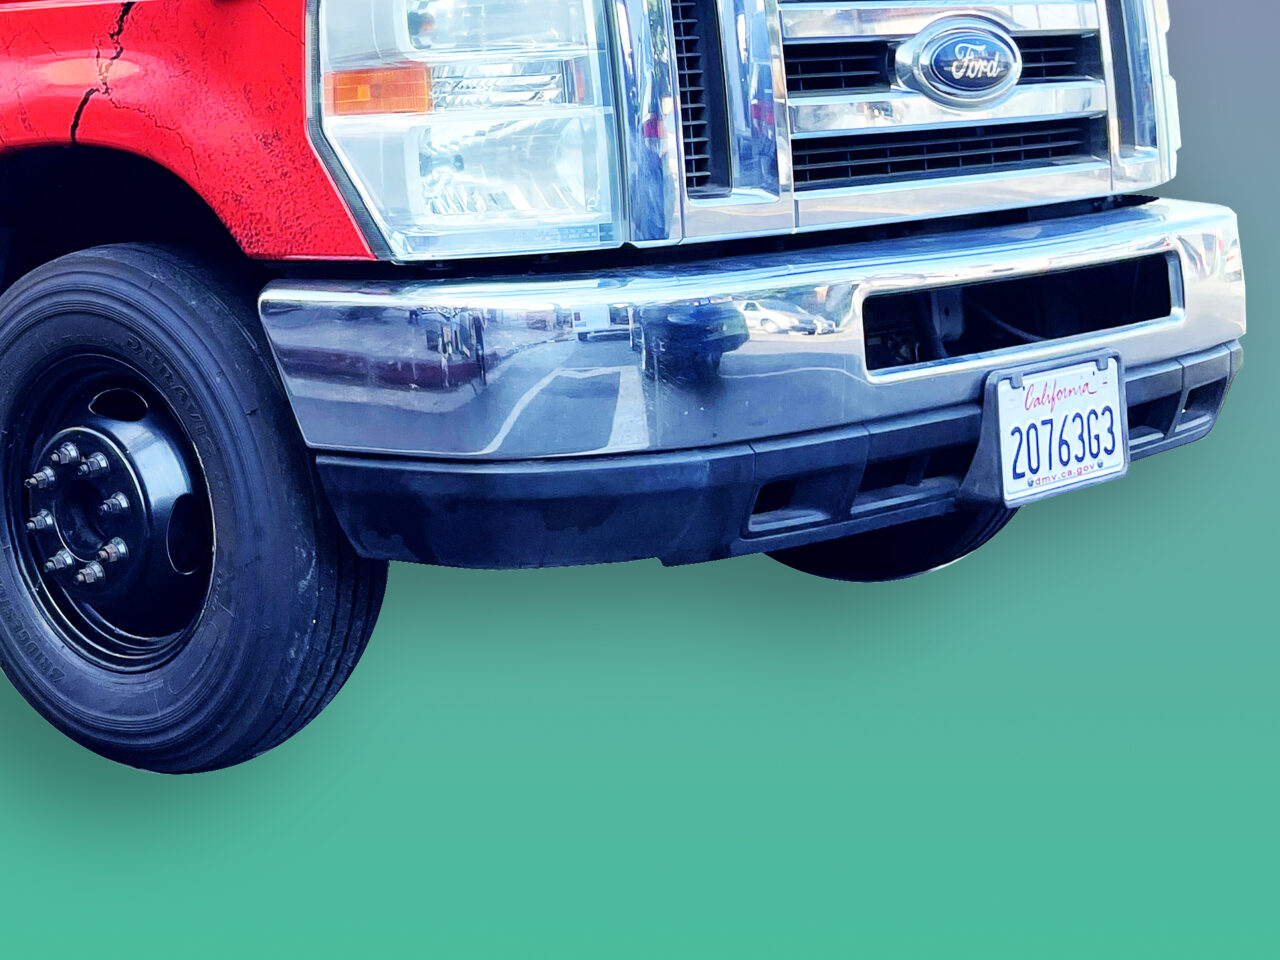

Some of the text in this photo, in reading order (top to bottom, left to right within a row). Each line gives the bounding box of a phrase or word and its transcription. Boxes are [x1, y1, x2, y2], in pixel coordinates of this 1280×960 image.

[951, 42, 1001, 80] Ford
[1024, 378, 1098, 414] California
[1010, 405, 1116, 480] 20763G3
[1034, 463, 1095, 486] dmv.ca.gov
